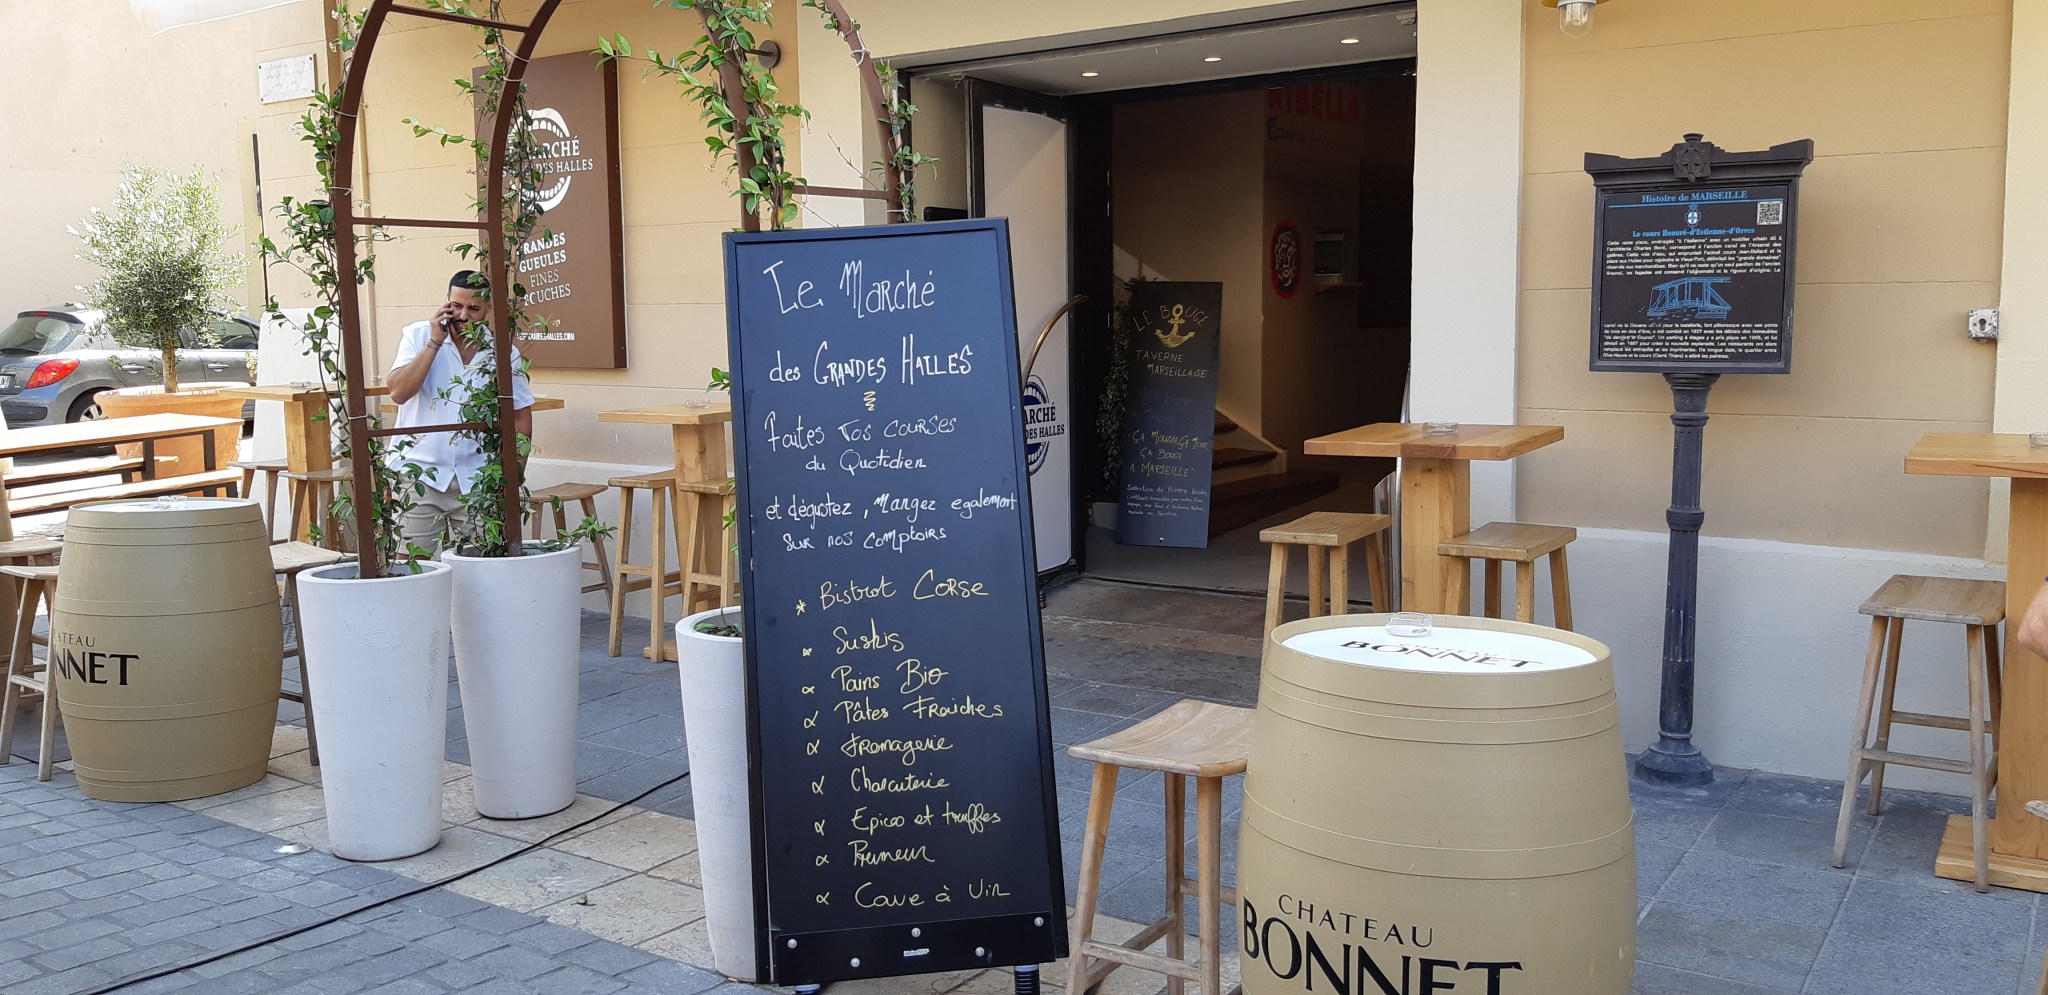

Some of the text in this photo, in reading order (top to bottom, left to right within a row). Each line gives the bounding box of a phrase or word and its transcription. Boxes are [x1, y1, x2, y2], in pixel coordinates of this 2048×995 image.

[556, 158, 593, 172] HALLES
[1642, 194, 1676, 203] Histoire
[1691, 190, 1747, 200] MARSEILLE
[516, 232, 566, 255] RANDES
[519, 250, 567, 272] GUEULES
[530, 269, 560, 288] FINES
[763, 260, 824, 314] Le
[1133, 309, 1152, 332] LE
[769, 350, 800, 382] des
[1136, 349, 1183, 363] TAVERNE
[1024, 402, 1056, 424] ARCHÉ
[764, 411, 824, 452] Faites
[1039, 424, 1064, 438] HALLES
[806, 455, 826, 471] du
[766, 496, 782, 520] et
[820, 575, 896, 610] Bistrot
[55, 648, 140, 686] NNET
[1339, 640, 1543, 668] BONNET
[831, 658, 948, 694] Pains Bio
[834, 696, 888, 724] Pâtes
[851, 766, 950, 793] Charcuterie
[914, 804, 934, 826] et
[942, 800, 1001, 834] truffes
[854, 878, 1010, 908] Cave à Vin
[1278, 894, 1433, 948] CHATEAU
[1243, 896, 1523, 995] BONNET
